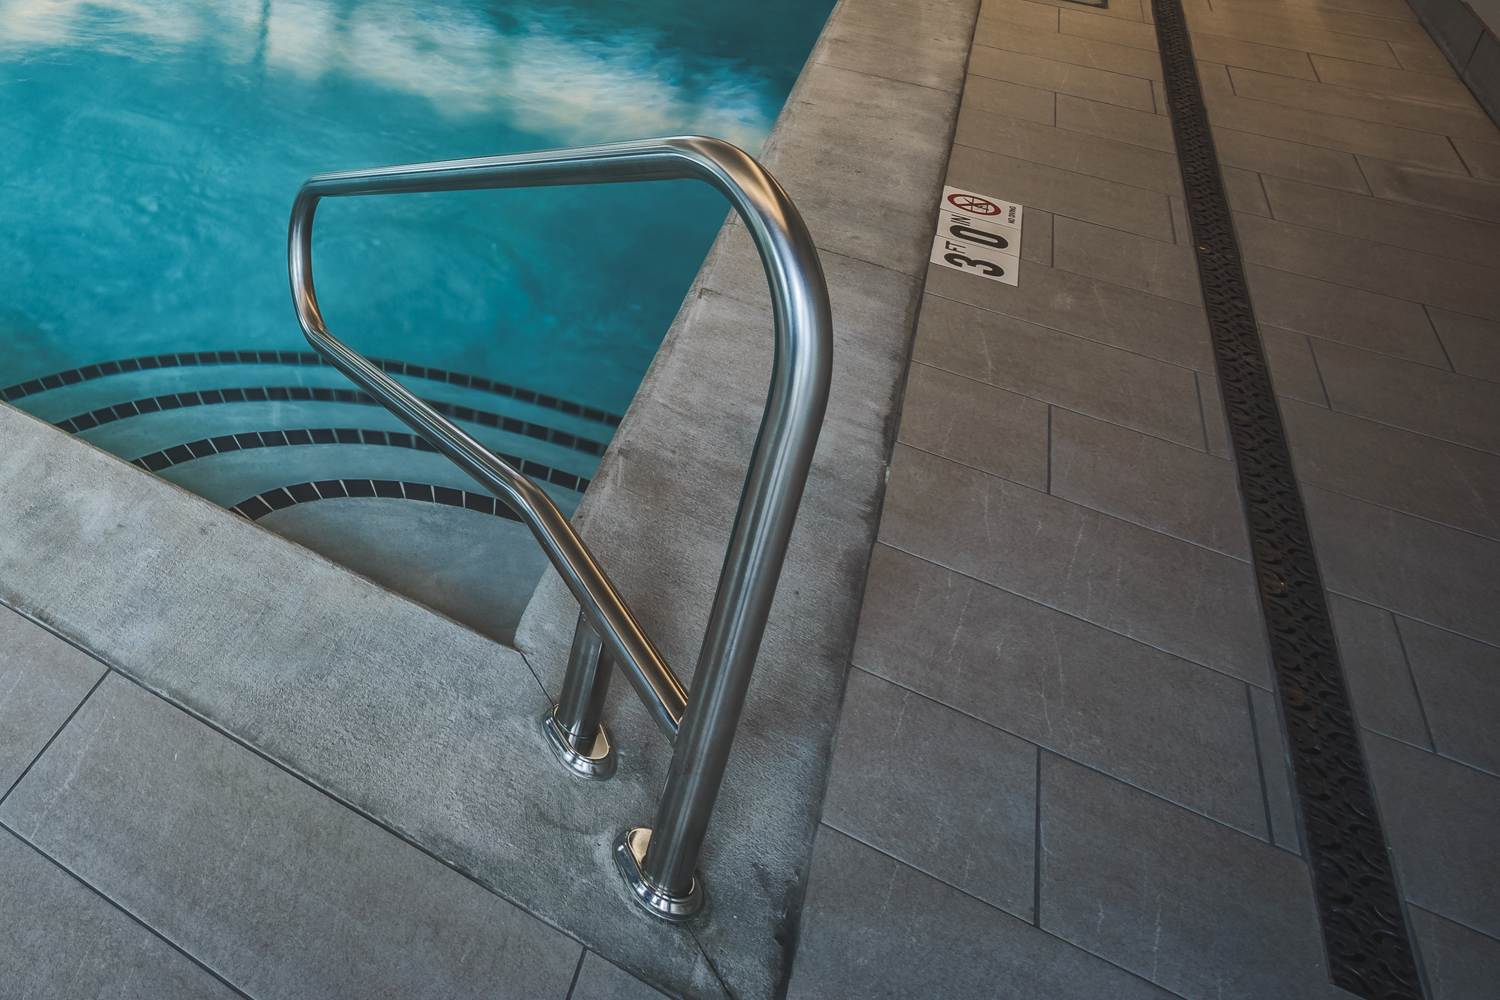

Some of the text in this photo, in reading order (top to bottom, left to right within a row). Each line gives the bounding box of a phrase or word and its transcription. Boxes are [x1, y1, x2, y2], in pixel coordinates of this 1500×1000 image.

[949, 213, 1009, 249] 0 IN
[943, 240, 1005, 278] 3 FT
